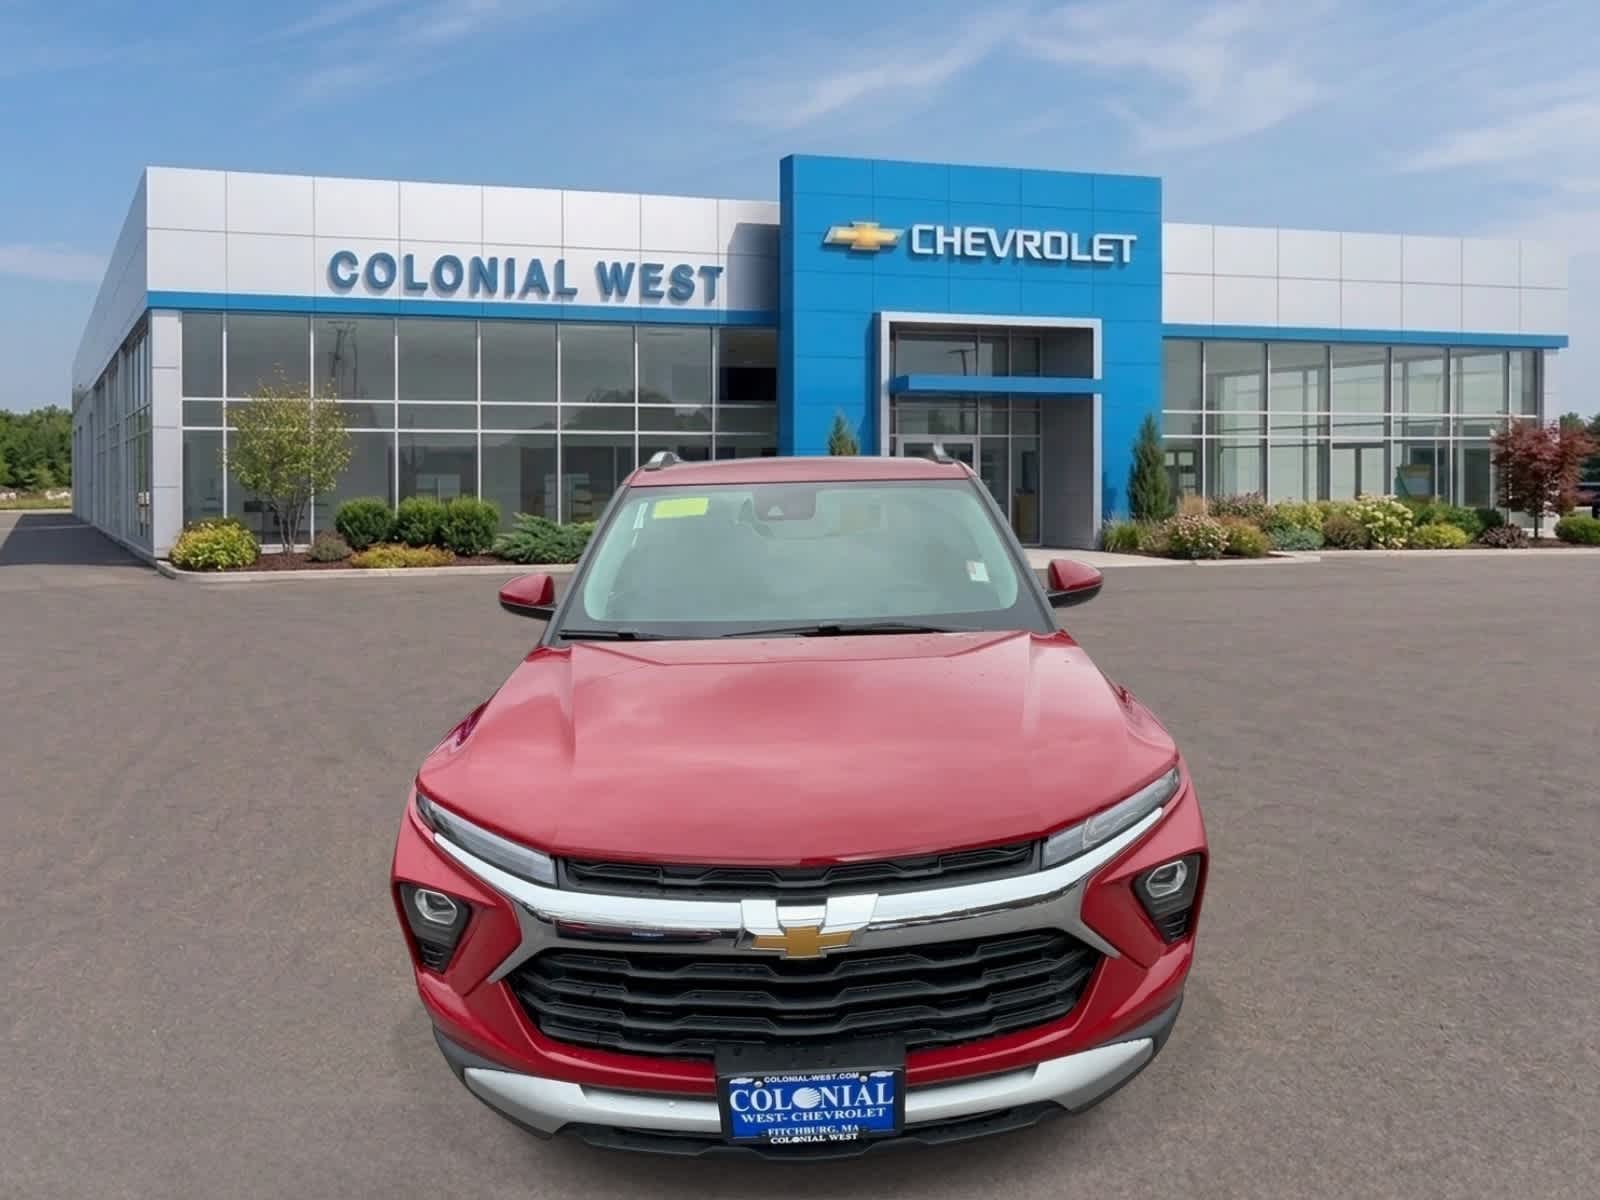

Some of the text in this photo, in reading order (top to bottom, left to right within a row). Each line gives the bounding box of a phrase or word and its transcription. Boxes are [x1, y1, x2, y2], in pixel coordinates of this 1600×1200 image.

[911, 223, 1138, 263] CHEVROLET
[327, 250, 724, 304] COLONIAL WEST
[763, 1073, 860, 1083] COLONIAL-WEST.COM
[729, 1083, 895, 1112] COLONIAL
[791, 1107, 887, 1122] CHEVROLET
[841, 1124, 860, 1133] MA
[770, 1133, 858, 1144] COLONIAL WEST
